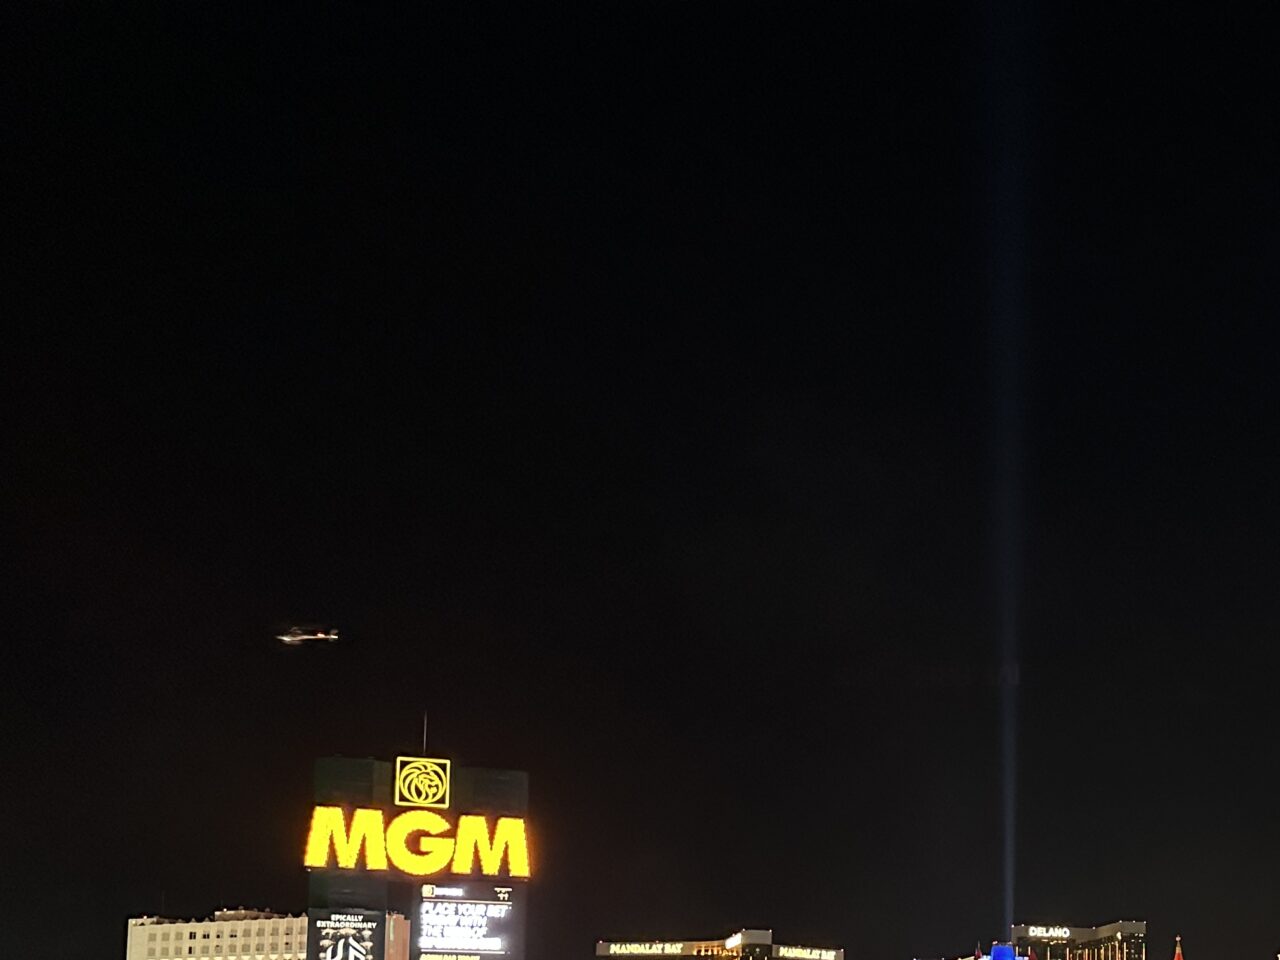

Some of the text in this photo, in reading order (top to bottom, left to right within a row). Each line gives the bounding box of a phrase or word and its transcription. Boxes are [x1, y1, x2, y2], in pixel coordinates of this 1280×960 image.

[304, 806, 530, 877] MGM
[331, 914, 363, 922] EPICALLY
[1029, 926, 1070, 938] DELANO
[610, 943, 683, 954] MANDALAY BAY
[779, 946, 836, 960] MANDALAY BAY
